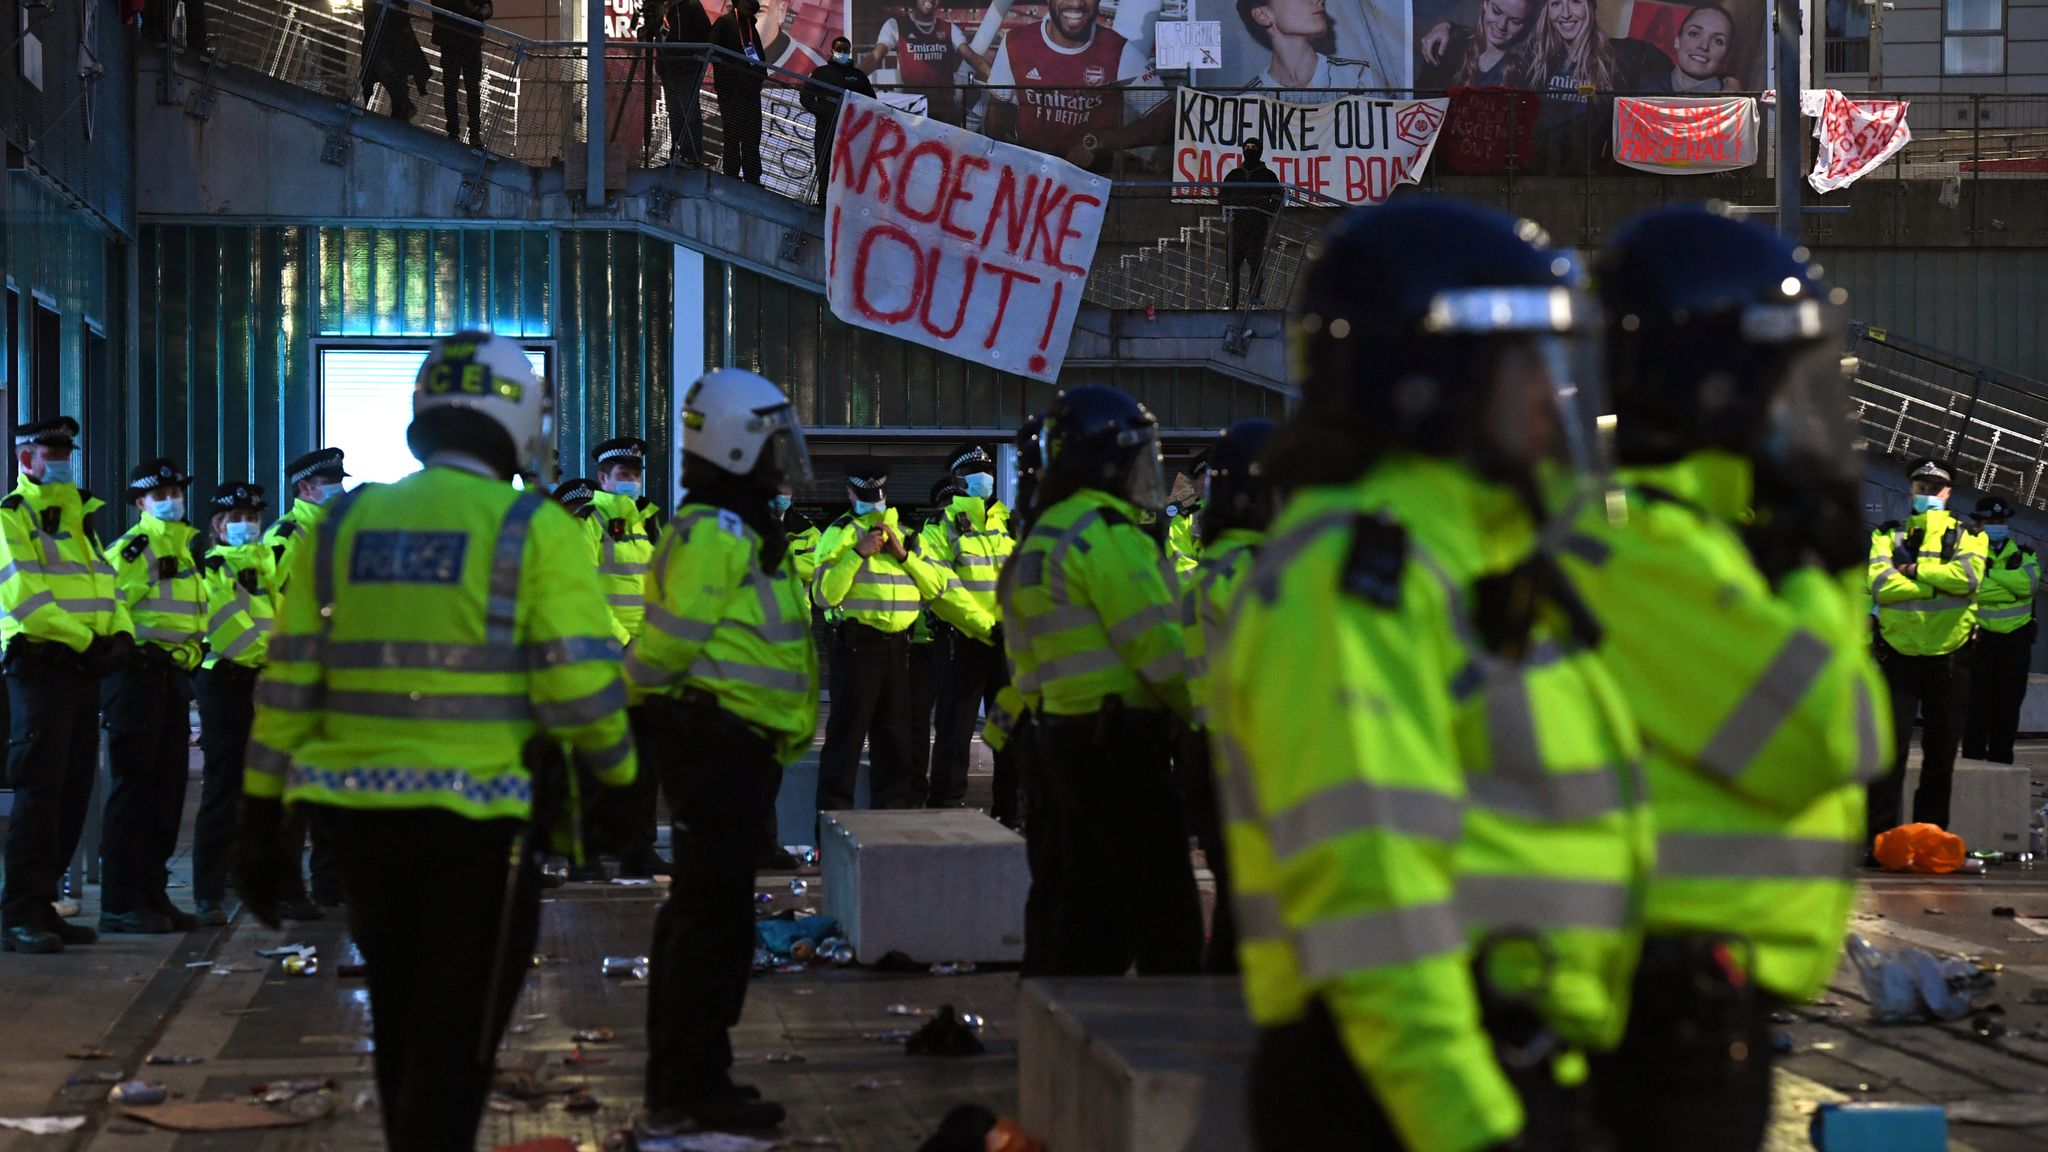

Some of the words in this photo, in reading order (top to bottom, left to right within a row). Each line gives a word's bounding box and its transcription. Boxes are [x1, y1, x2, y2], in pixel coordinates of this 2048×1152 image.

[907, 43, 947, 53] Emirates
[1025, 88, 1103, 111] Emirates
[1055, 109, 1090, 126] BETTER
[1179, 90, 1319, 151] KROENKE
[1334, 100, 1394, 150] OUT
[831, 103, 1100, 277] KROENKE
[1176, 147, 1244, 198] SAC
[1272, 156, 1332, 202] THE
[853, 223, 1064, 373] OUT!
